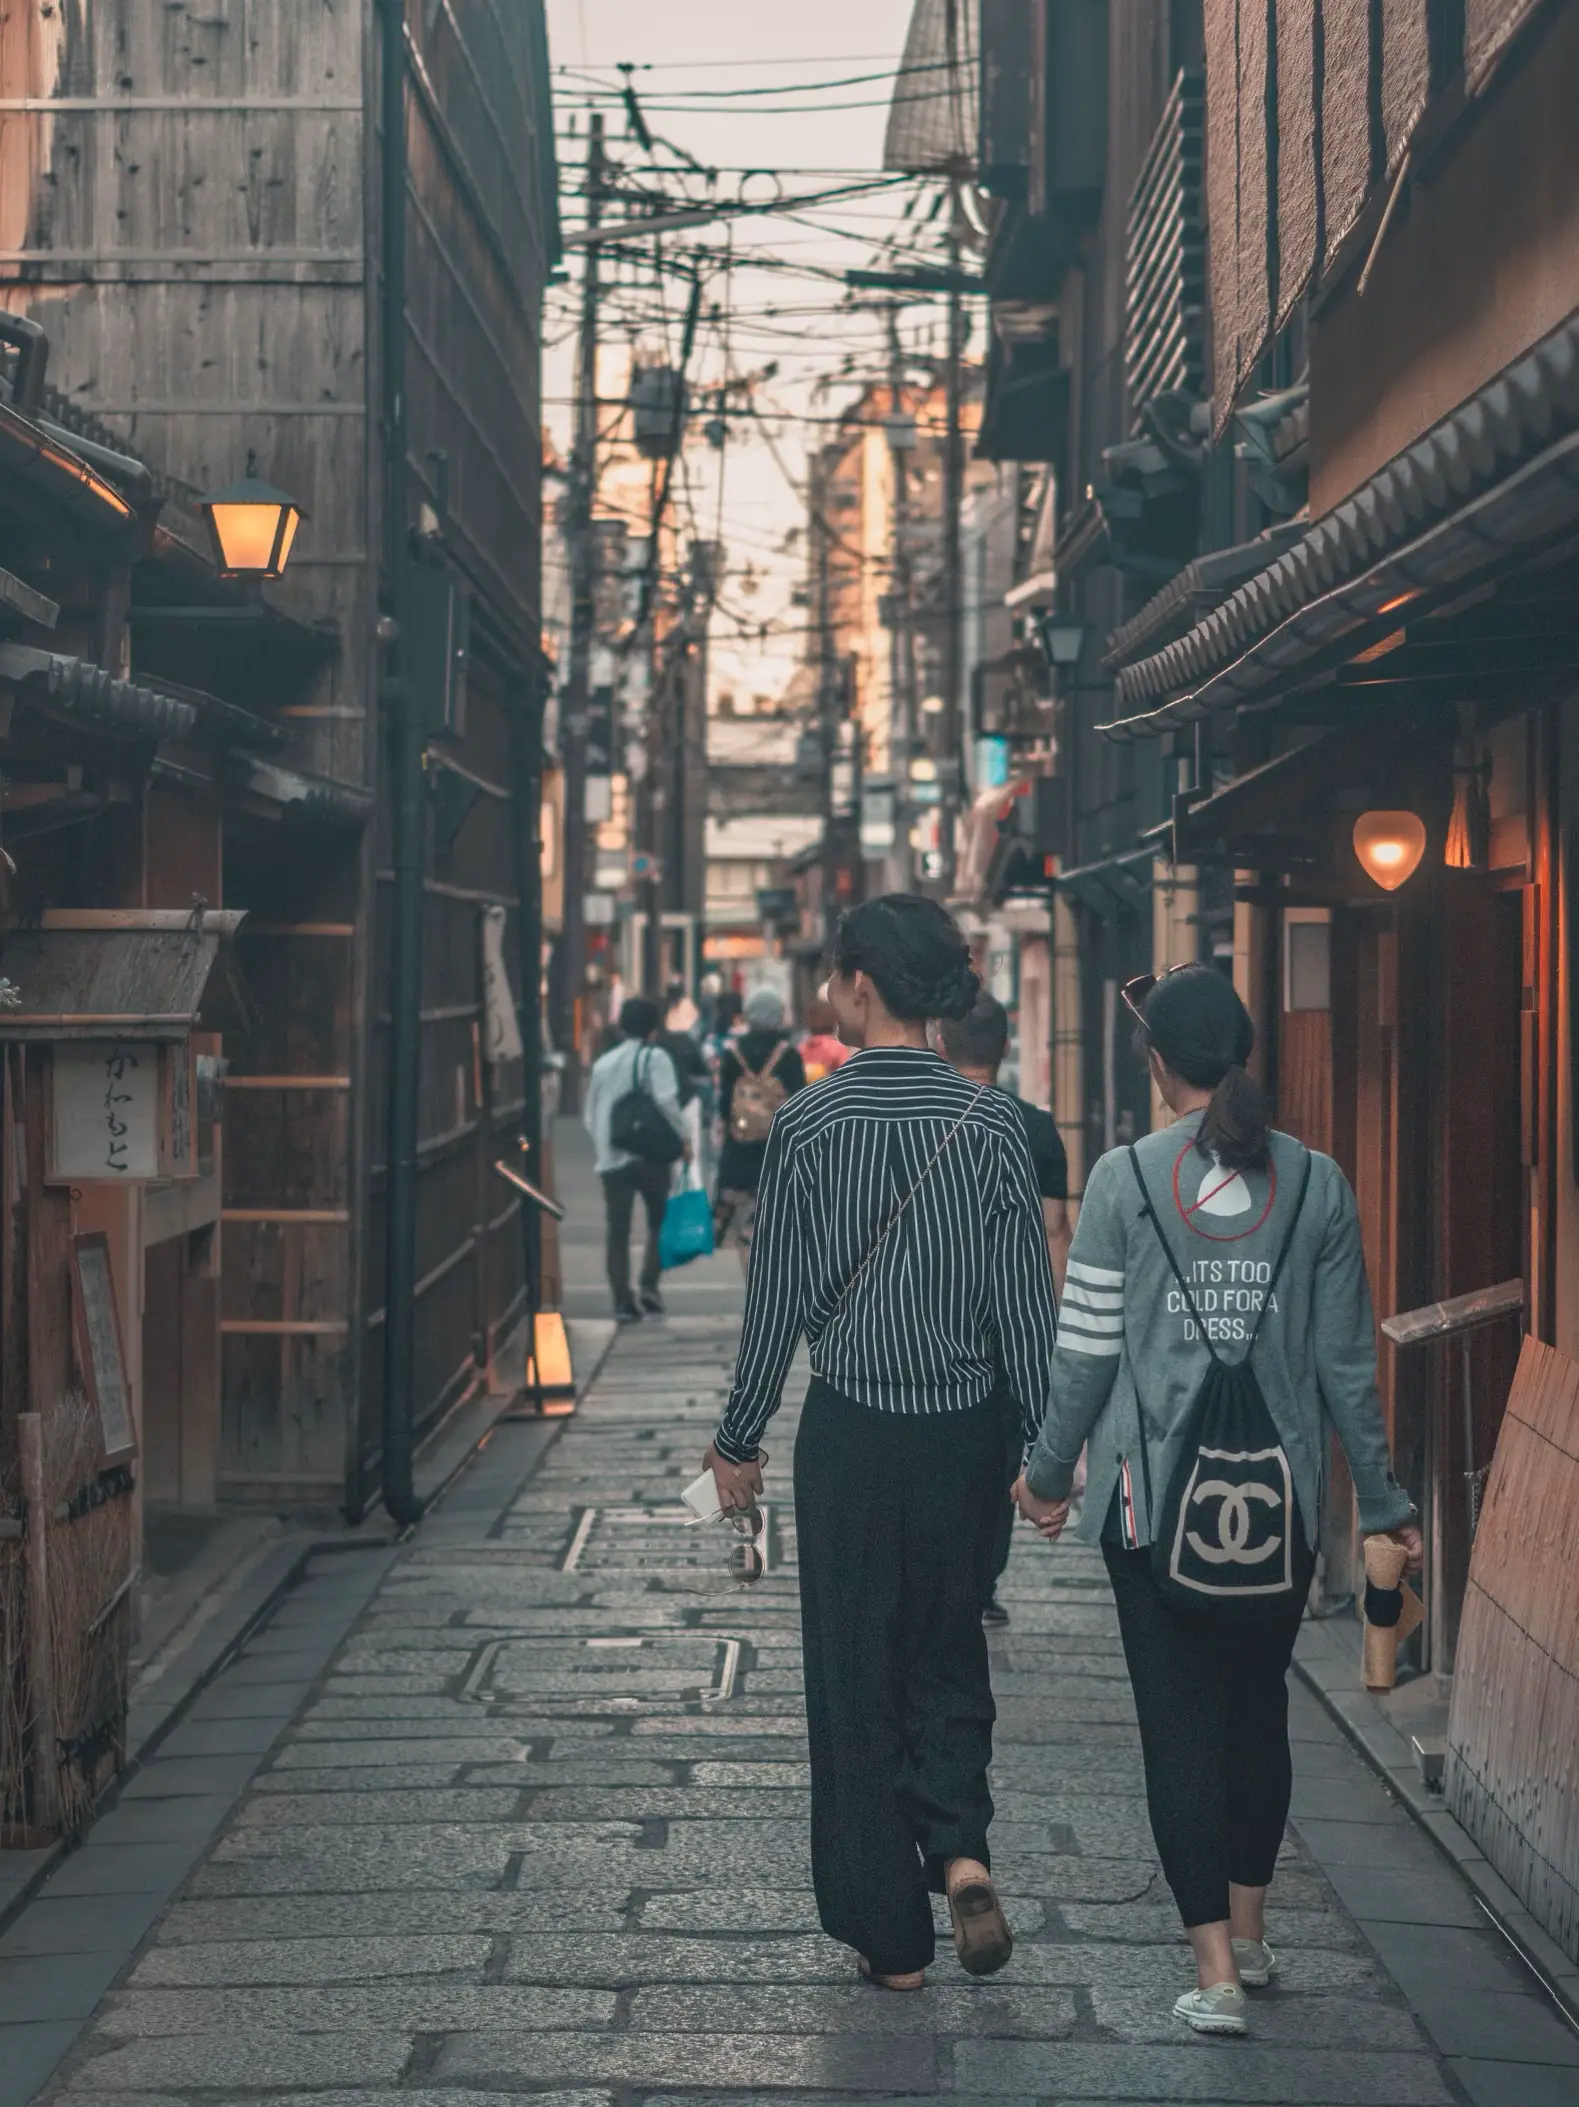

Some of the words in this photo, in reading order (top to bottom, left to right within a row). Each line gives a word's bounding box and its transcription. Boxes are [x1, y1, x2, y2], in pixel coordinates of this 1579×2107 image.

[1227, 1260, 1271, 1284] TOO
[1223, 1289, 1264, 1312] FOR
[1265, 1292, 1279, 1313] A
